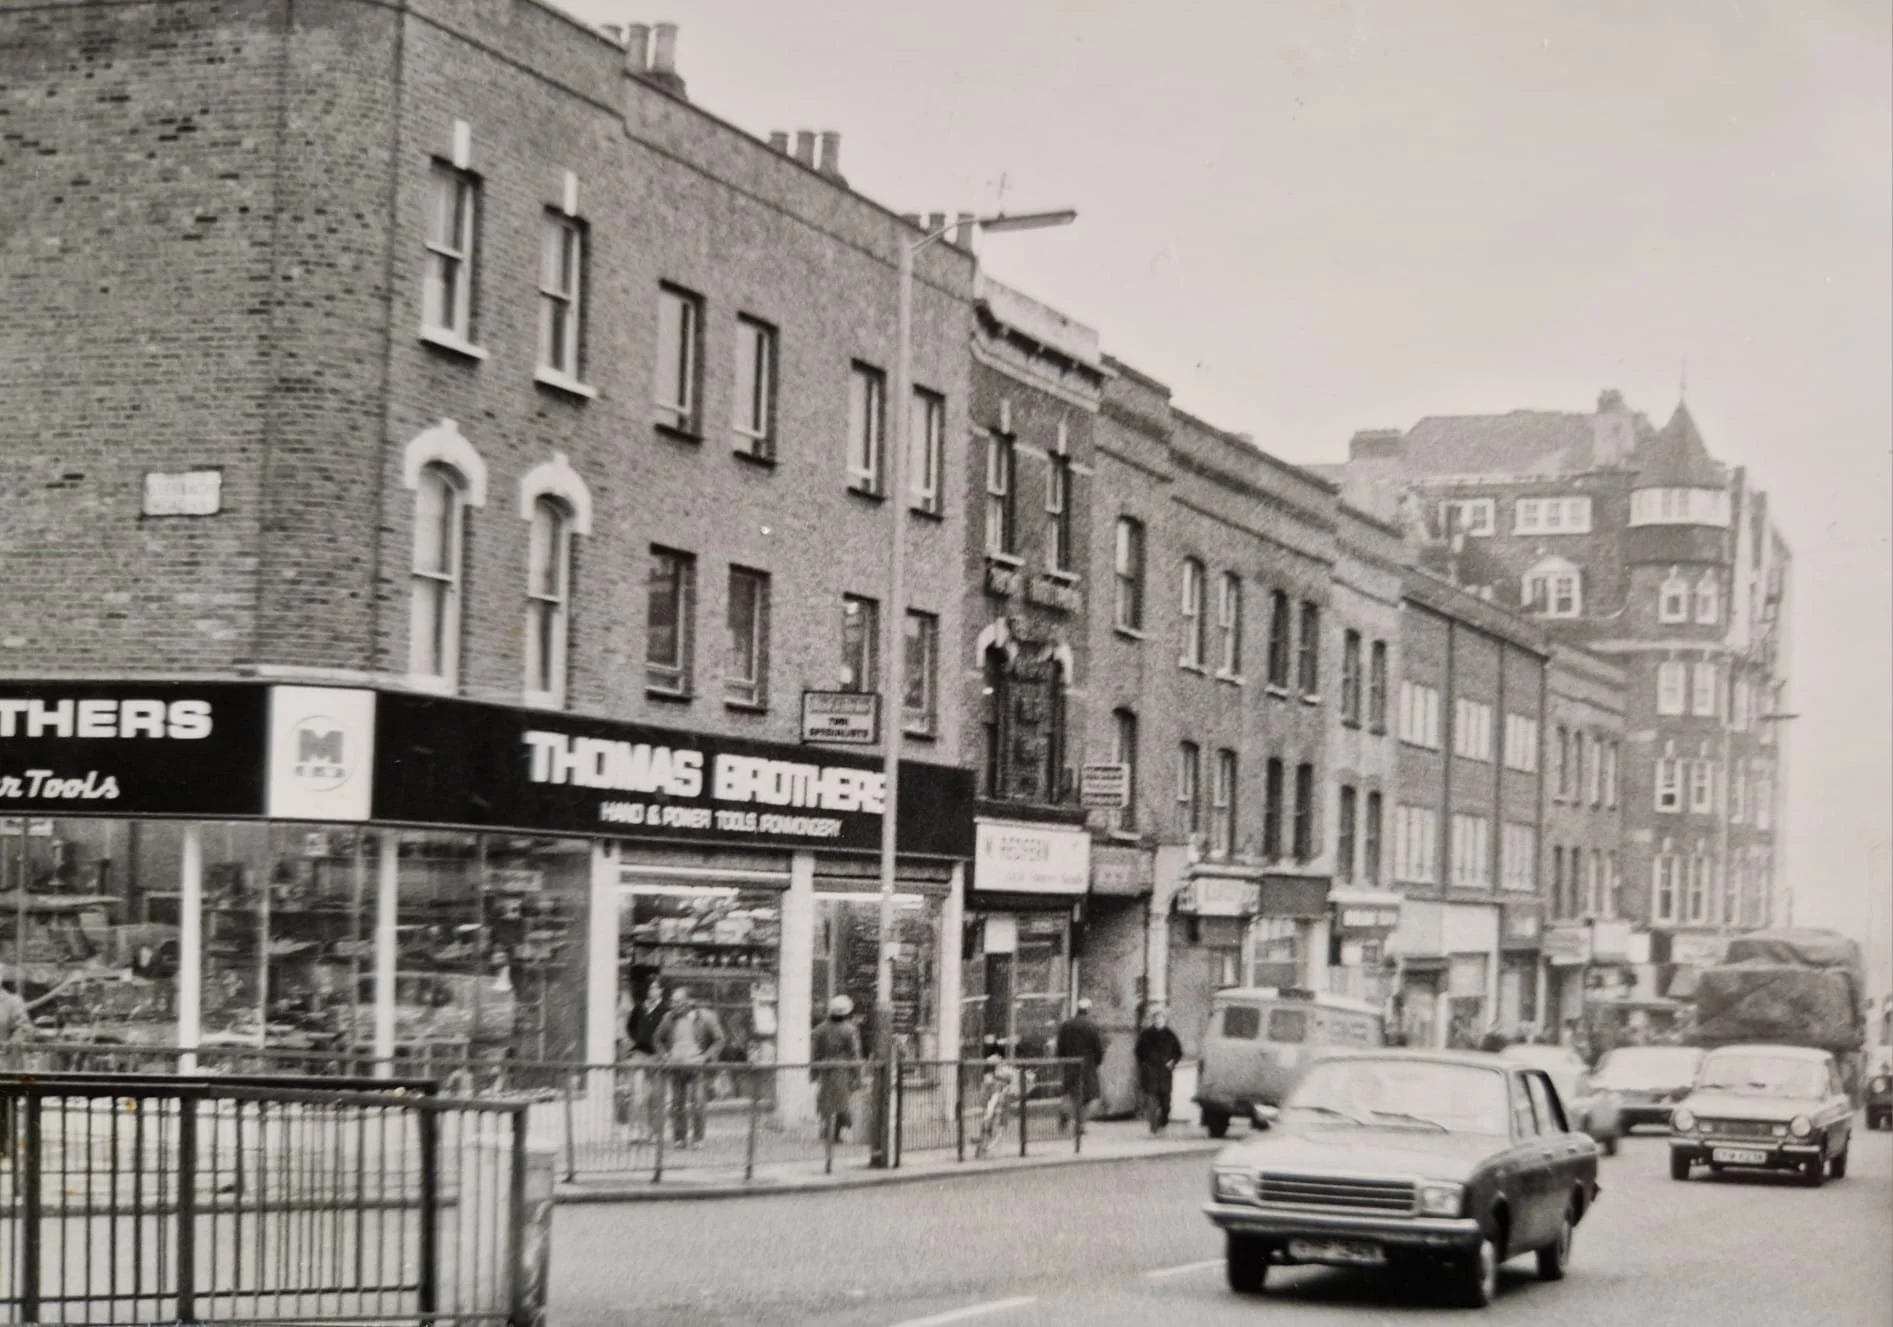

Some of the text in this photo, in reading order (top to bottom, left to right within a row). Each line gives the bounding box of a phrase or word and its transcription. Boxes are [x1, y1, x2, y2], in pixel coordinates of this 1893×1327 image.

[297, 728, 344, 764] M
[24, 769, 120, 799] Tools
[522, 729, 886, 815] THOMAS BROTHERS
[599, 800, 645, 825] HAND
[646, 804, 662, 825] &
[662, 805, 712, 829] POWER
